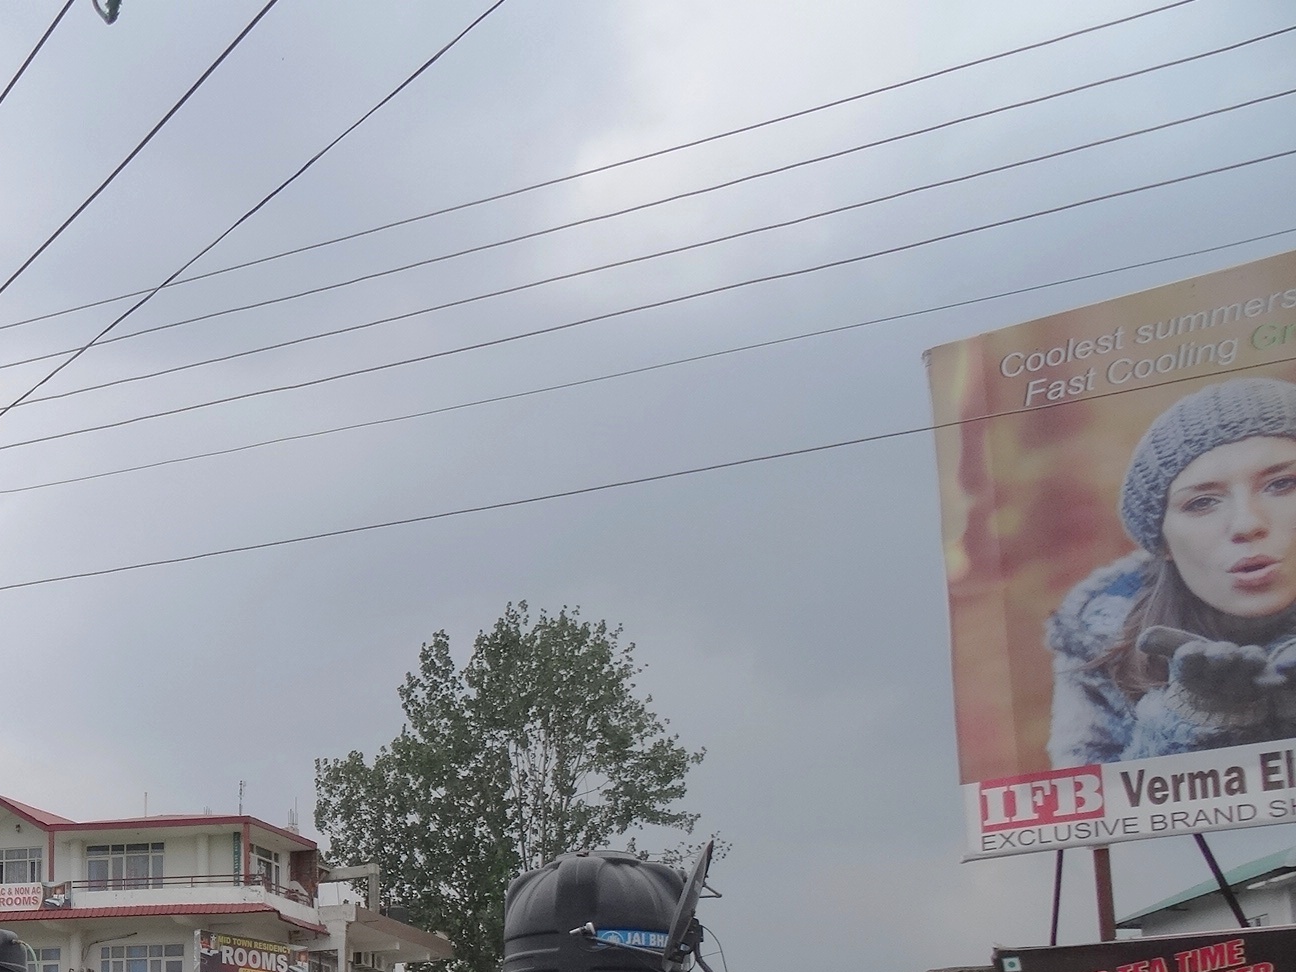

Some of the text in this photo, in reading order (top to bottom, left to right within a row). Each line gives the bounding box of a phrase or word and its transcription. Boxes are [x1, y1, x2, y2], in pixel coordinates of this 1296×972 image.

[1000, 288, 1296, 379] Coolest summers
[1024, 369, 1096, 407] Fast
[1106, 337, 1240, 386] Cooling
[981, 772, 1105, 827] IFB
[1120, 762, 1247, 808] Verma
[981, 815, 1140, 852] EXCLUSIVE
[1150, 803, 1258, 832] BRAND
[14, 887, 30, 895] NON
[31, 886, 42, 894] AC
[232, 937, 253, 948] TOWN
[253, 942, 292, 954] RESIDENCY
